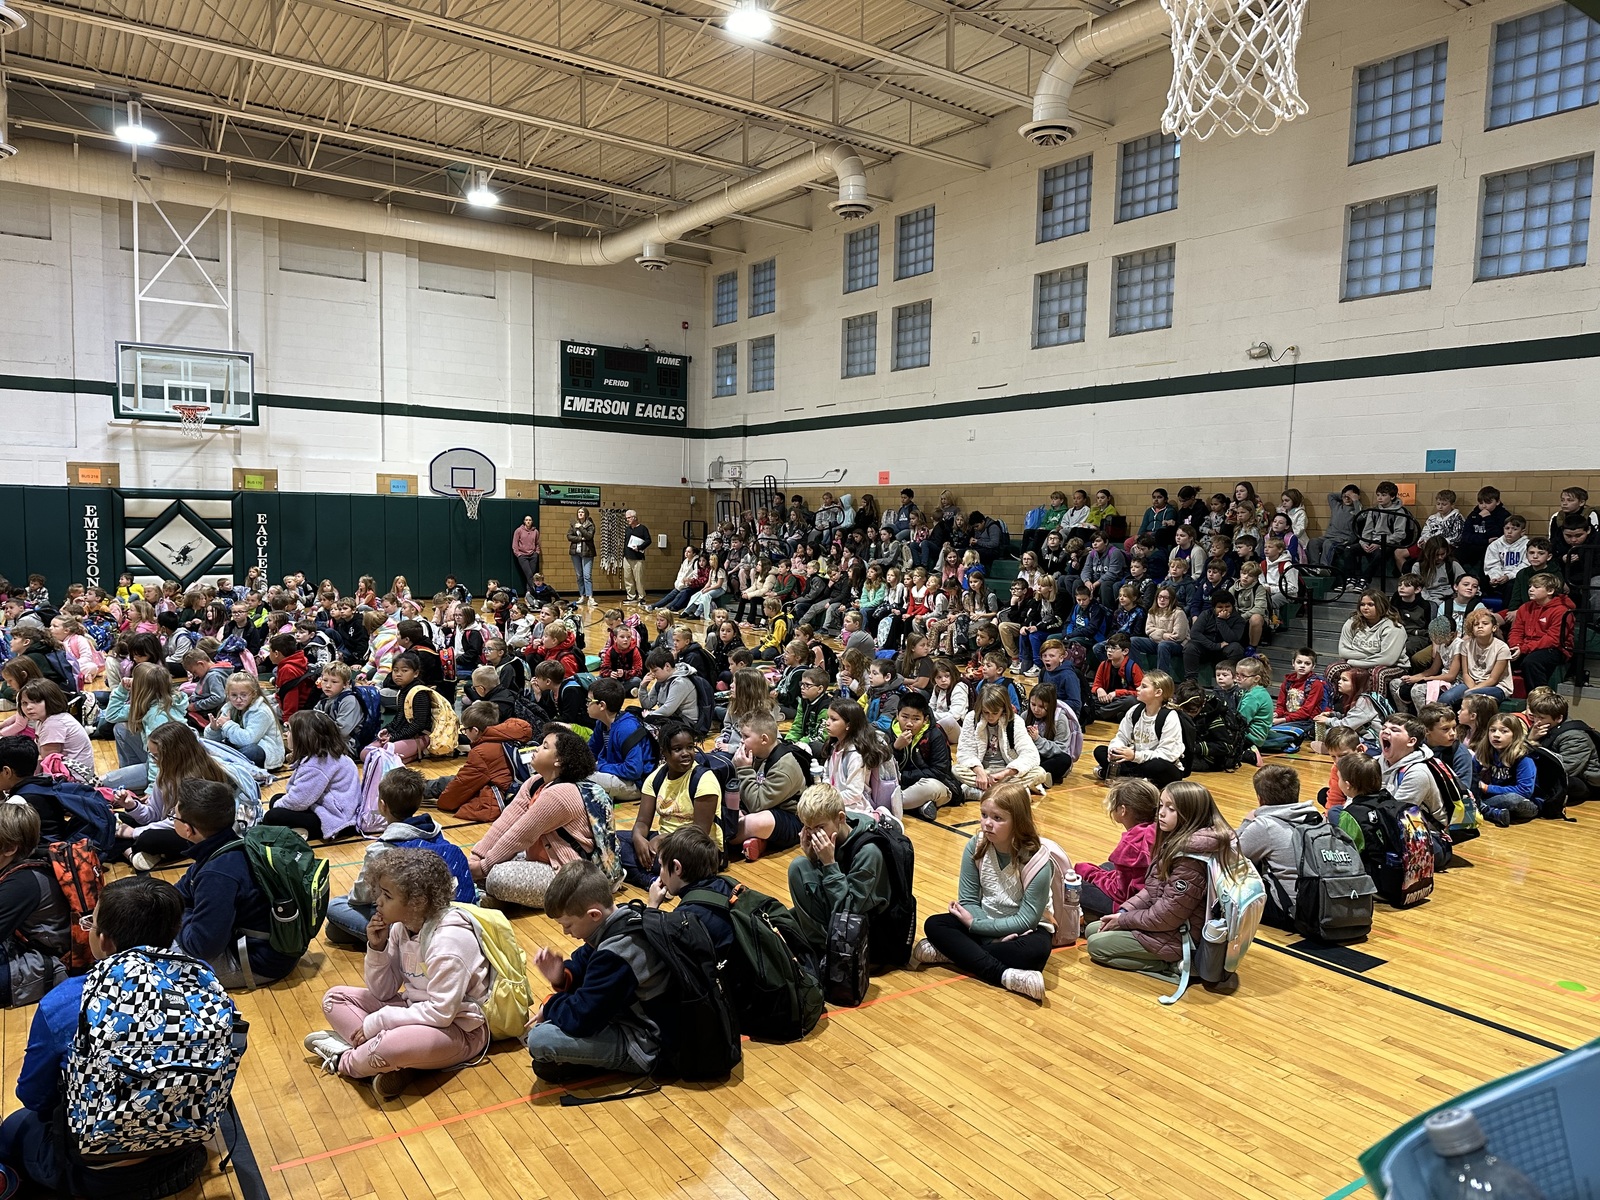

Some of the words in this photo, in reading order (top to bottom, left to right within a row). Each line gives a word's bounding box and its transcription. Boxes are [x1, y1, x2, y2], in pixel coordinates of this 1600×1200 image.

[566, 344, 597, 356] GUEST
[656, 356, 681, 366] HOME
[603, 378, 630, 388] PERIOD
[563, 396, 630, 416] EMERSON
[634, 403, 686, 421] EAGLES
[83, 504, 100, 588] EMERSON
[256, 513, 268, 580] EAGLES
